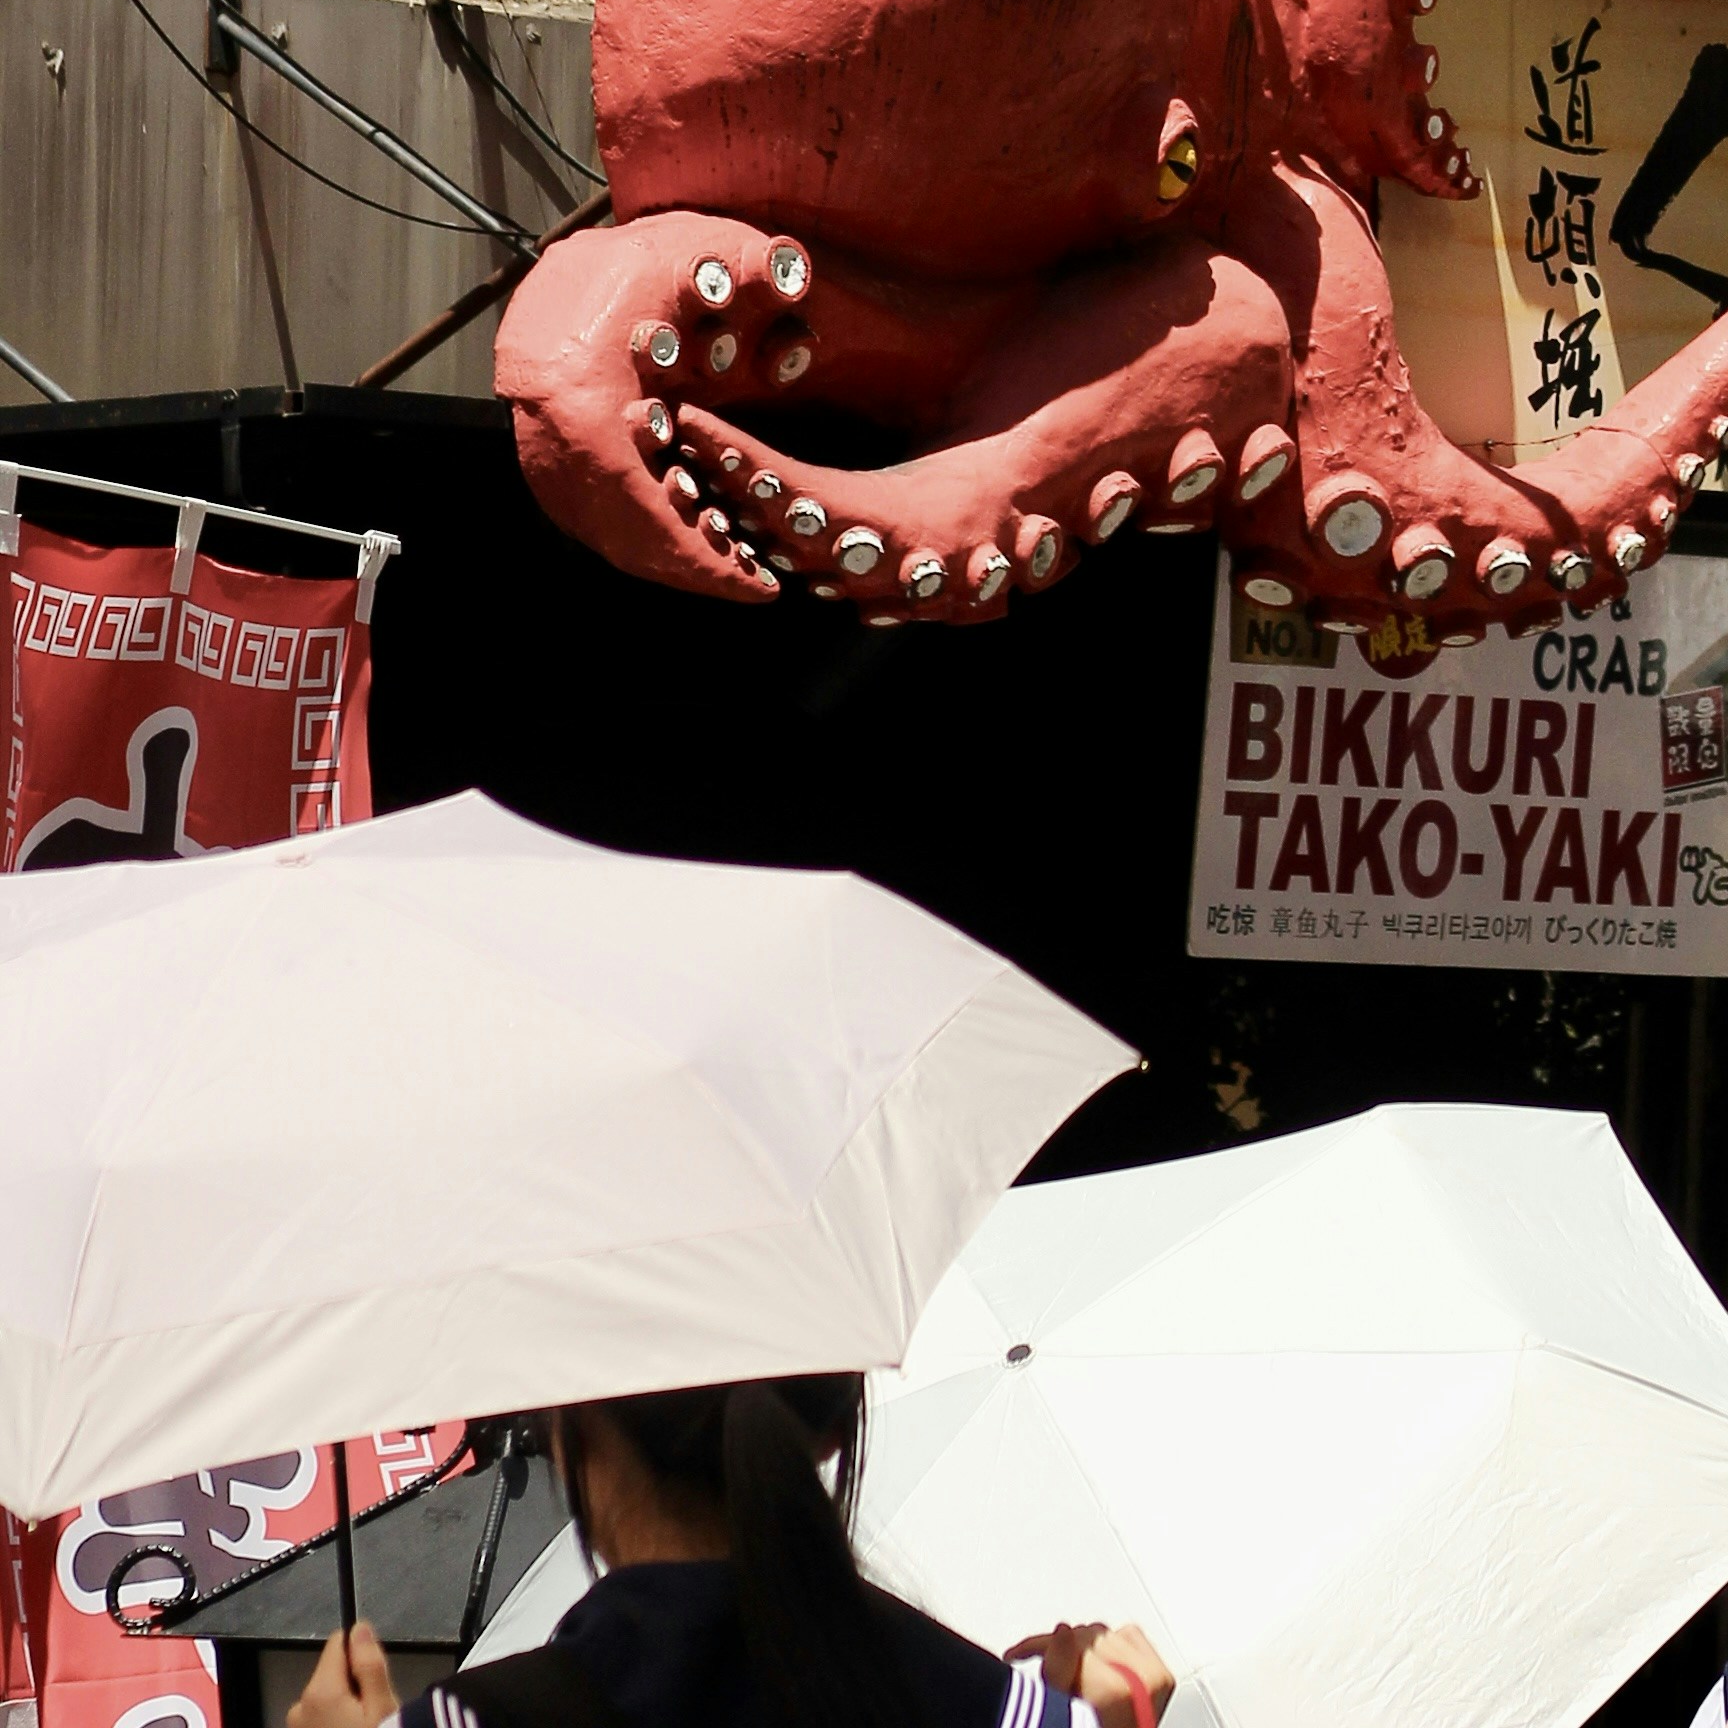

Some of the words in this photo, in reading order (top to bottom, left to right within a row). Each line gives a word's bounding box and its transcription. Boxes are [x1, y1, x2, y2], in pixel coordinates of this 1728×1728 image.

[1523, 15, 1607, 432] 道頓堀
[1531, 631, 1668, 698] CRAB
[1225, 680, 1598, 800] BIKKURI
[1222, 789, 1684, 909] TAKO-YAKI
[1206, 902, 1257, 937] 吃惊
[1269, 907, 1370, 940] 章鱼丸子
